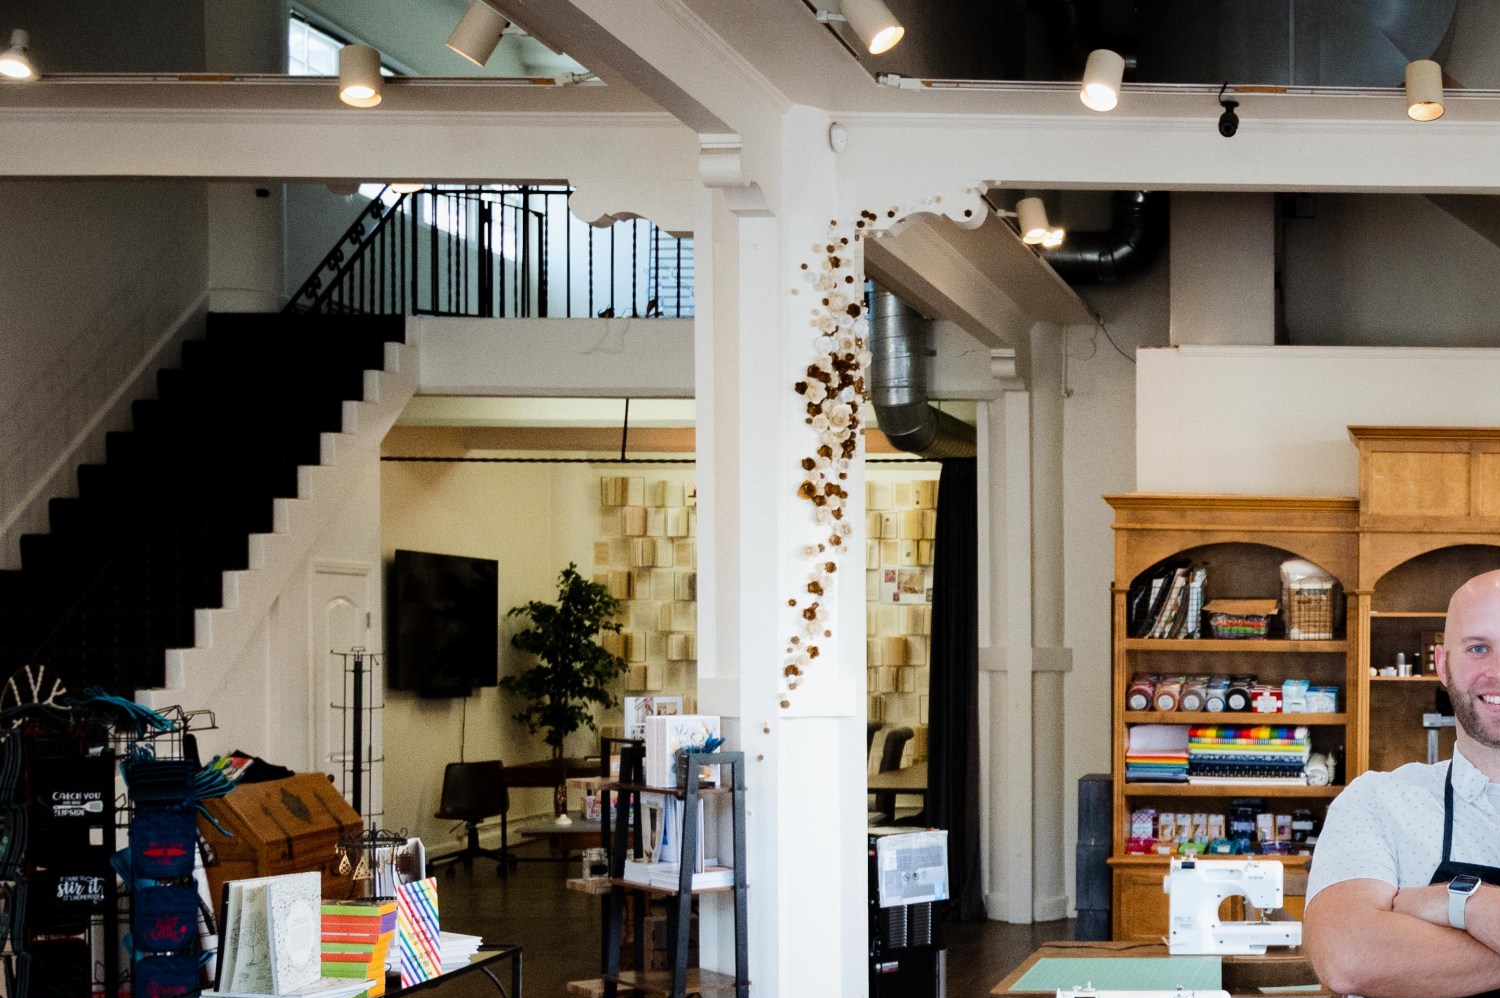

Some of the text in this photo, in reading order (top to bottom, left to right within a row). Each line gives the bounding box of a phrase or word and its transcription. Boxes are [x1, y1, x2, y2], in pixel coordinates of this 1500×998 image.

[52, 791, 101, 801] CATCH YOU
[56, 881, 85, 898] stir
